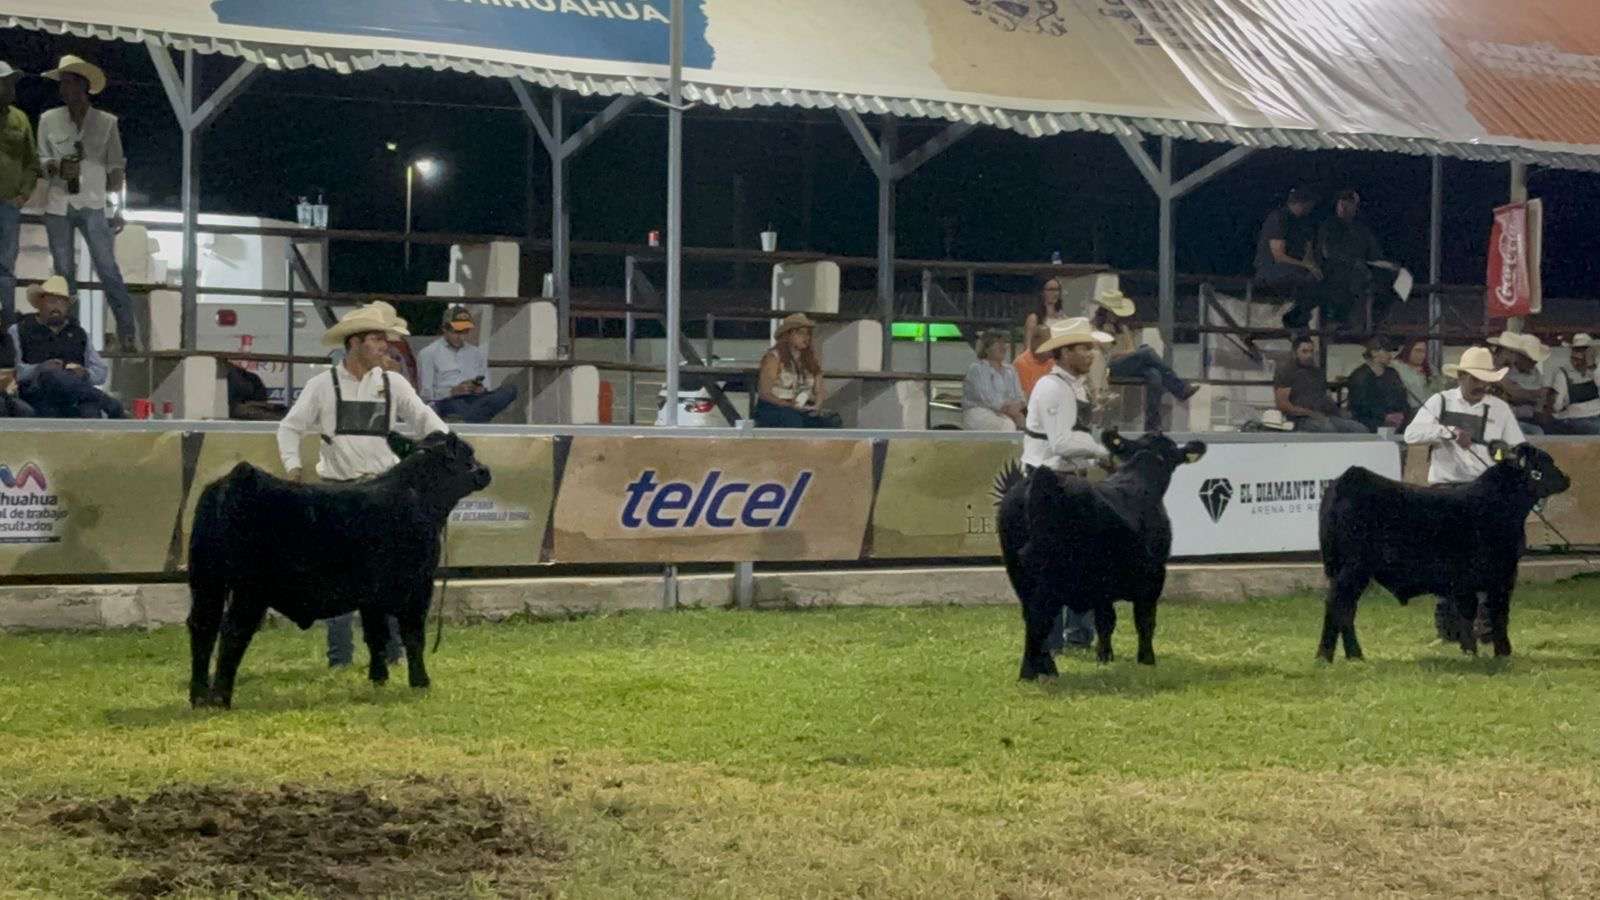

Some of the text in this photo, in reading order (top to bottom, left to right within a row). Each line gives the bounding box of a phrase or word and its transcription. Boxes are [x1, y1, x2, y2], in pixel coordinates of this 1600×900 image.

[448, 0, 671, 24] UAHUA
[0, 492, 58, 505] huahua
[621, 470, 812, 528] telcel
[1240, 484, 1252, 503] EL
[1256, 480, 1315, 502] DIAMANTE
[10, 508, 24, 519] de
[26, 508, 68, 521] trabajo
